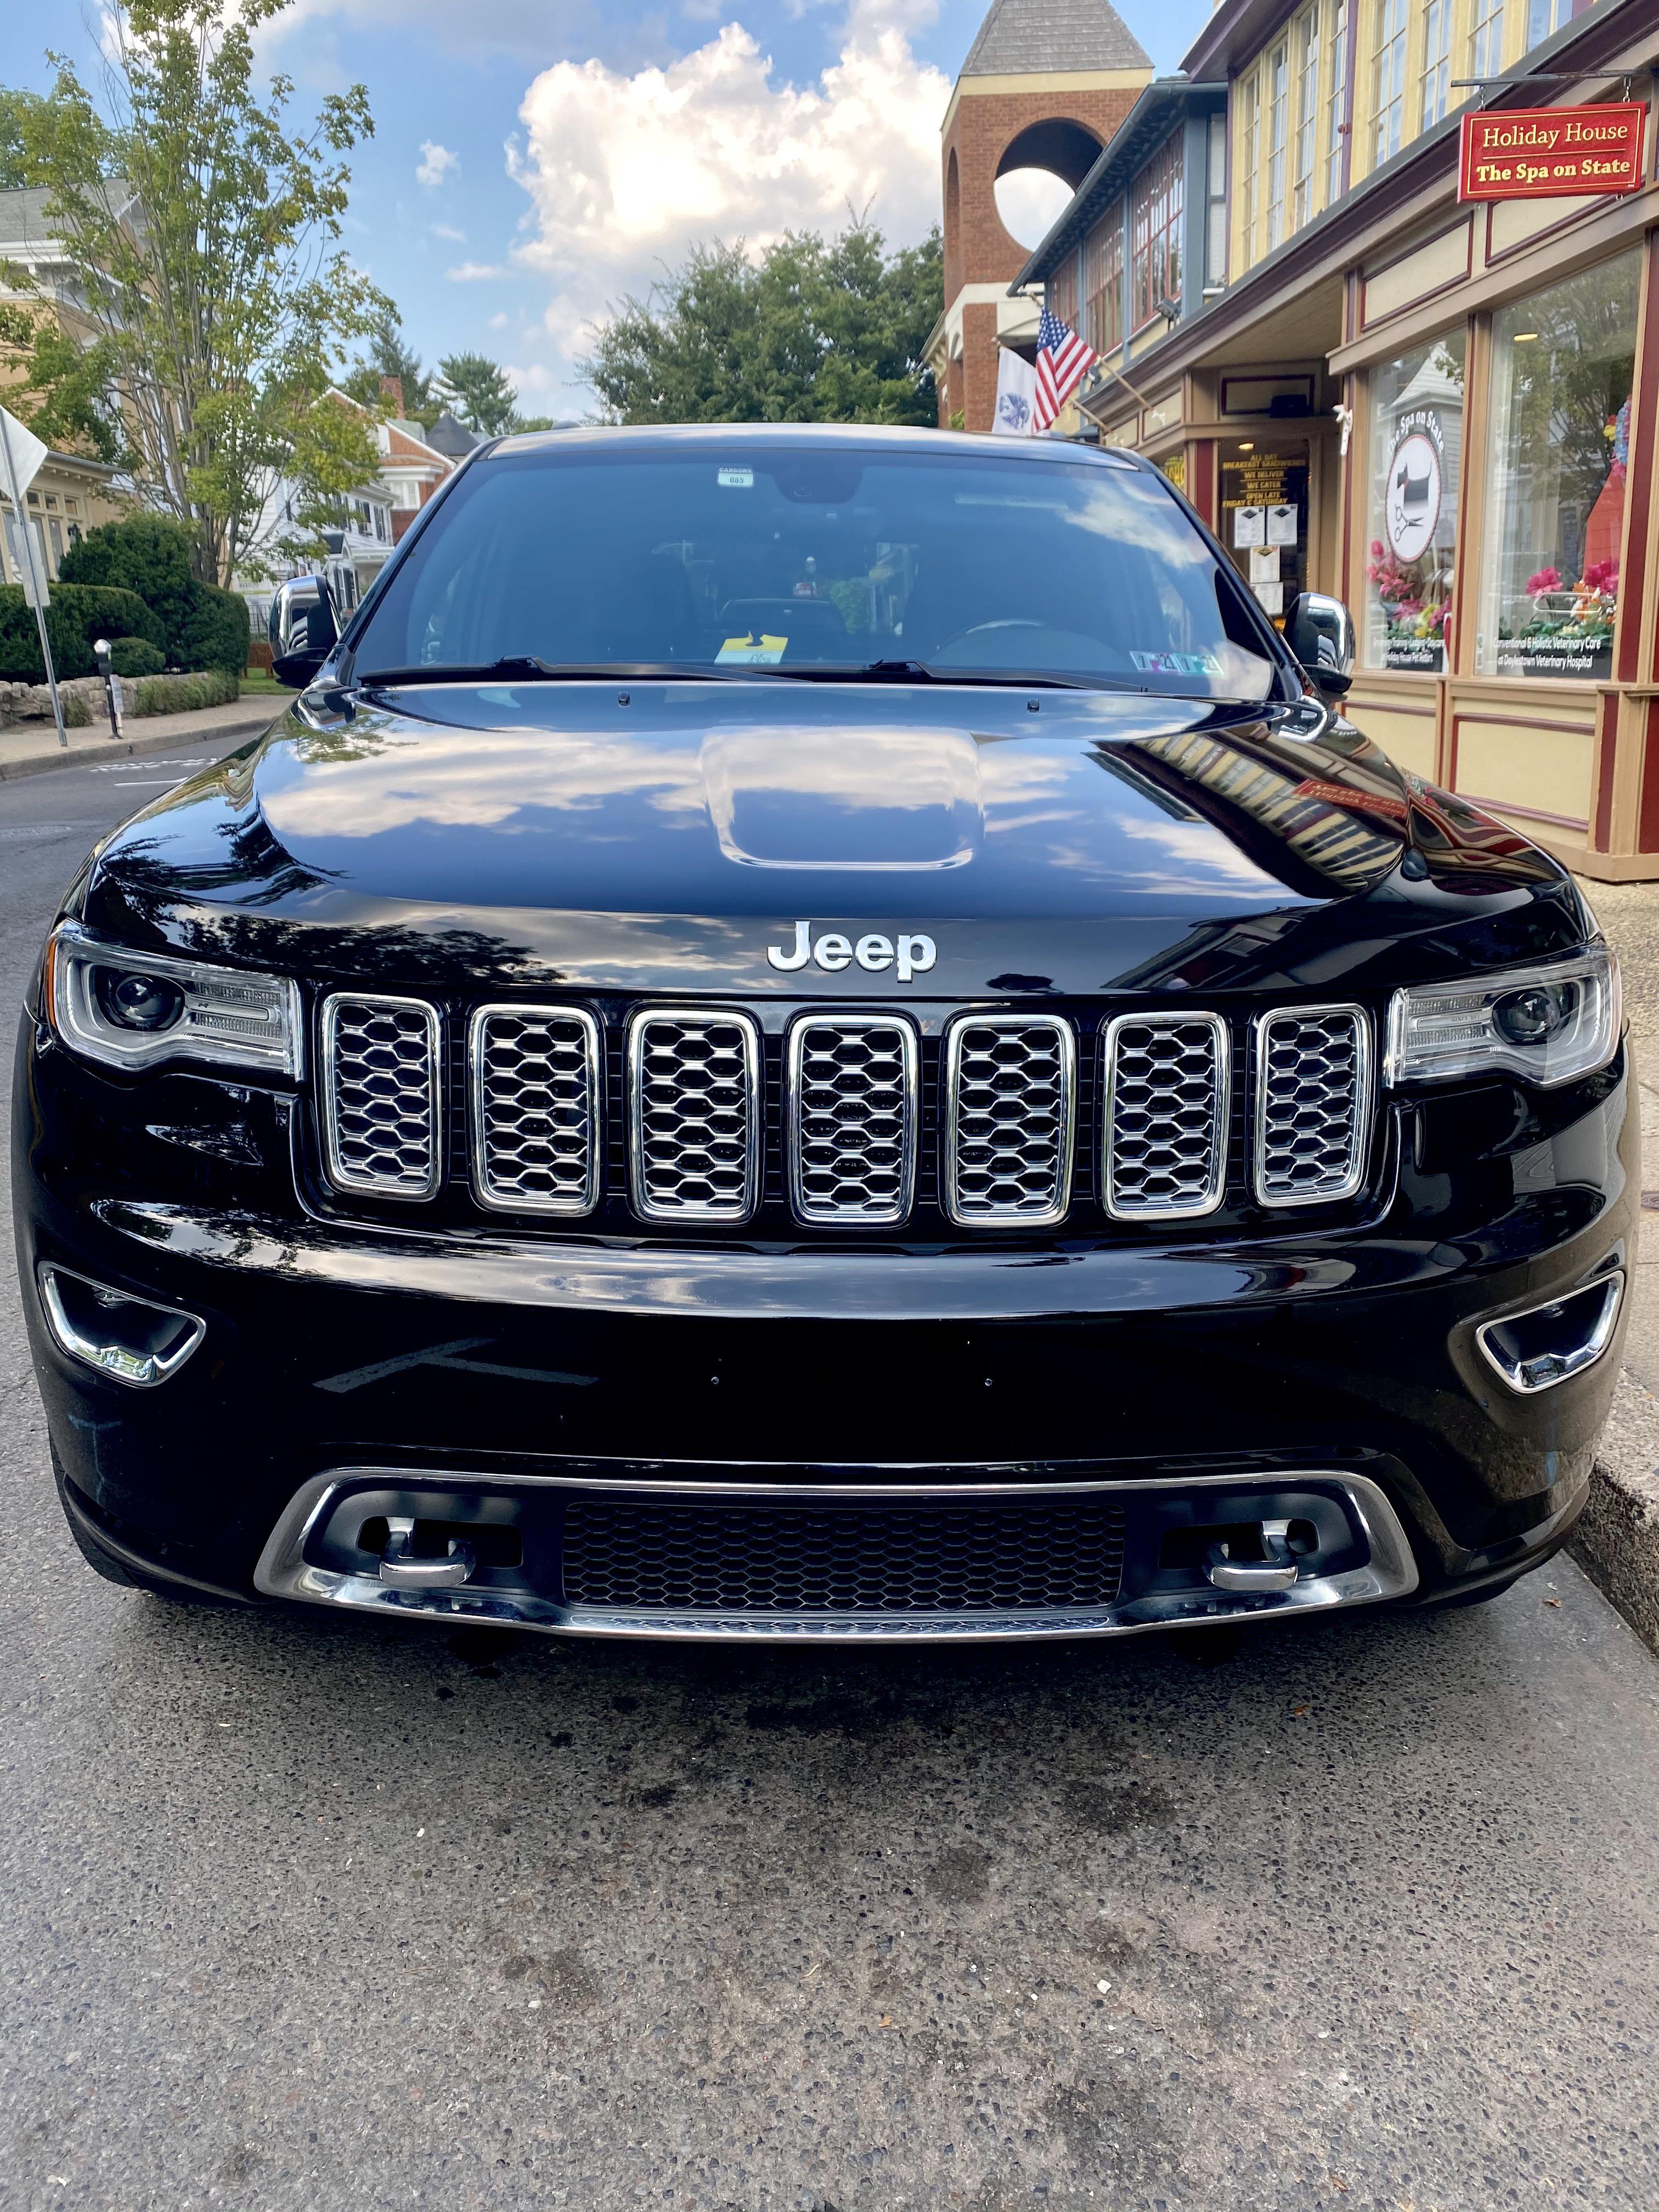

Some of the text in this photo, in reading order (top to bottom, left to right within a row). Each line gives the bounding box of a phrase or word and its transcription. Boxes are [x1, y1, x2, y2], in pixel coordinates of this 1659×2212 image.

[1482, 122, 1628, 149] Holiday House
[1476, 158, 1630, 184] The Spa on State
[1401, 413, 1415, 434] Spa
[1415, 411, 1426, 424] on
[1426, 410, 1444, 454] State
[1222, 500, 1246, 508] FRIDAY
[1493, 636, 1527, 648] Conventional
[1532, 637, 1553, 649] Holistic
[1553, 637, 1585, 653] Veterinary
[1585, 636, 1601, 650] Care
[1498, 654, 1593, 672] at Doylestown Veterinary Hospital
[767, 921, 937, 983] Jeep
